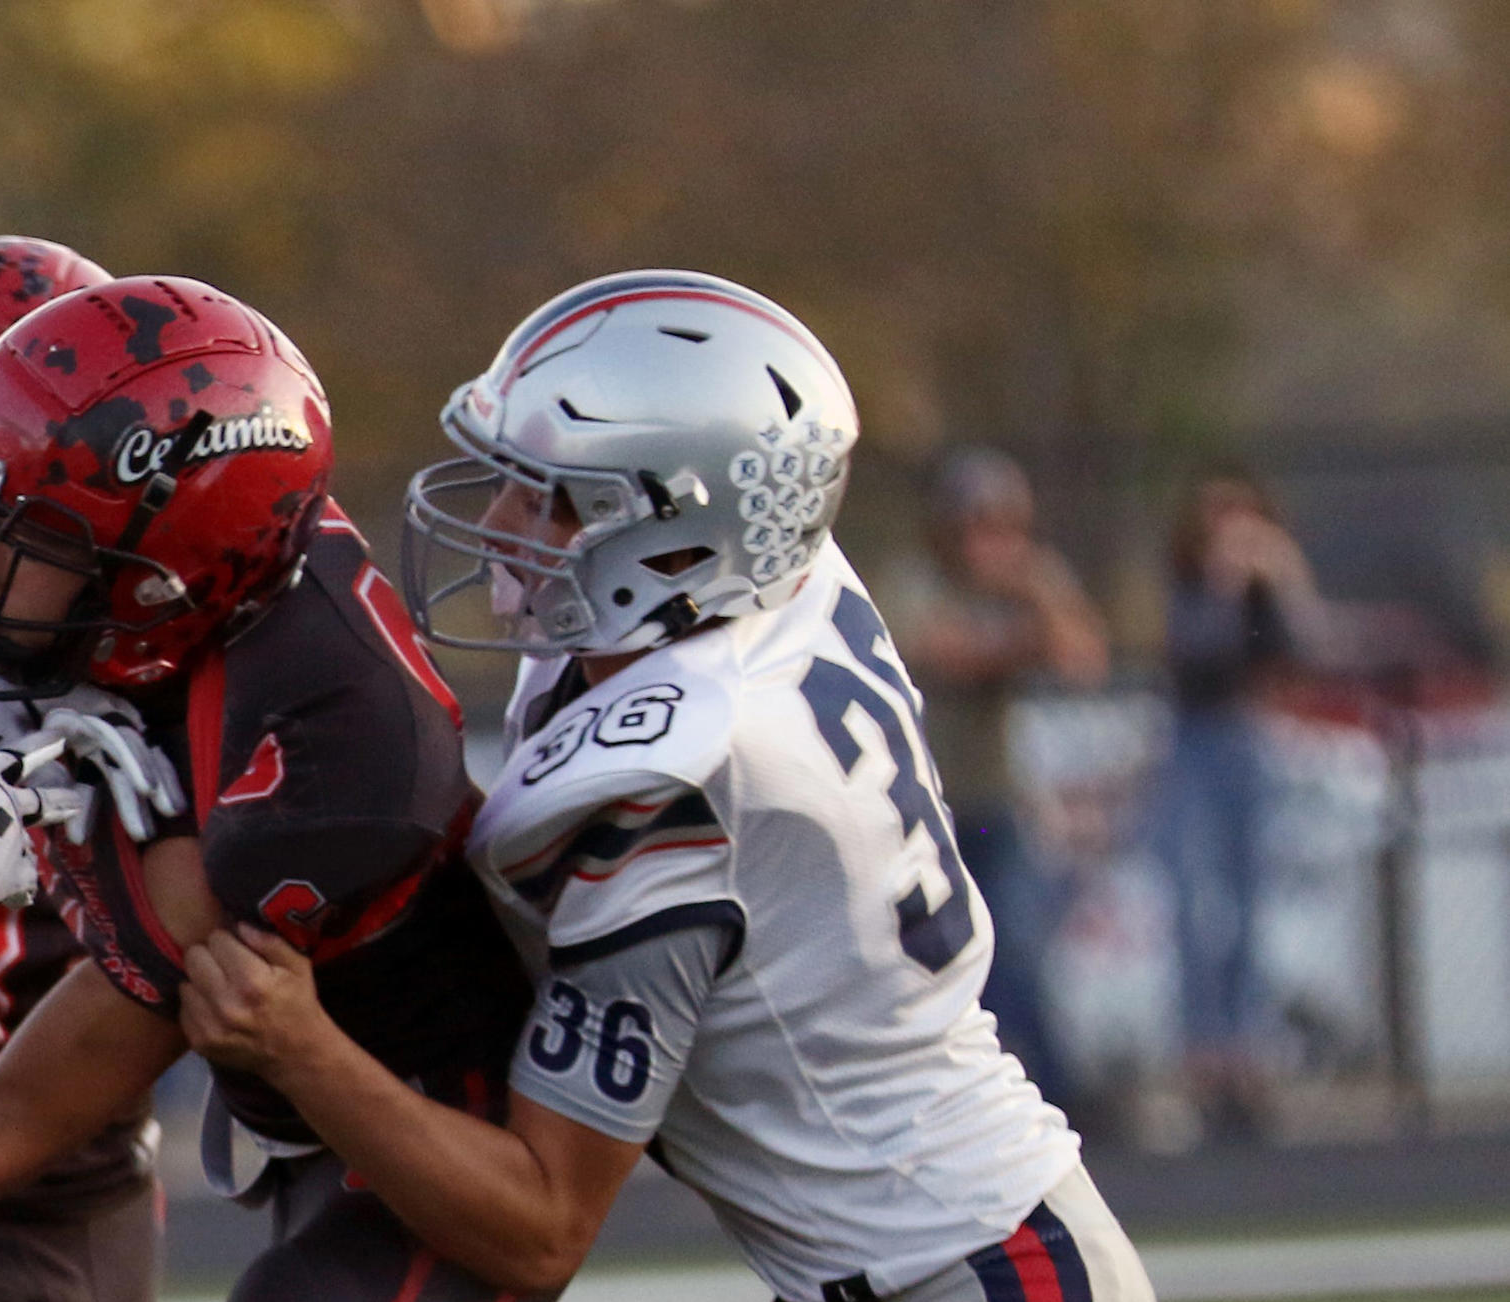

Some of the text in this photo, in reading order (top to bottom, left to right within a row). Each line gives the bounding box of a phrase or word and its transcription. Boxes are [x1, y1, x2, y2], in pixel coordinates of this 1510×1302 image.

[117, 405, 314, 483] Ceamics
[521, 683, 684, 785] 36
[529, 980, 653, 1104] 36
